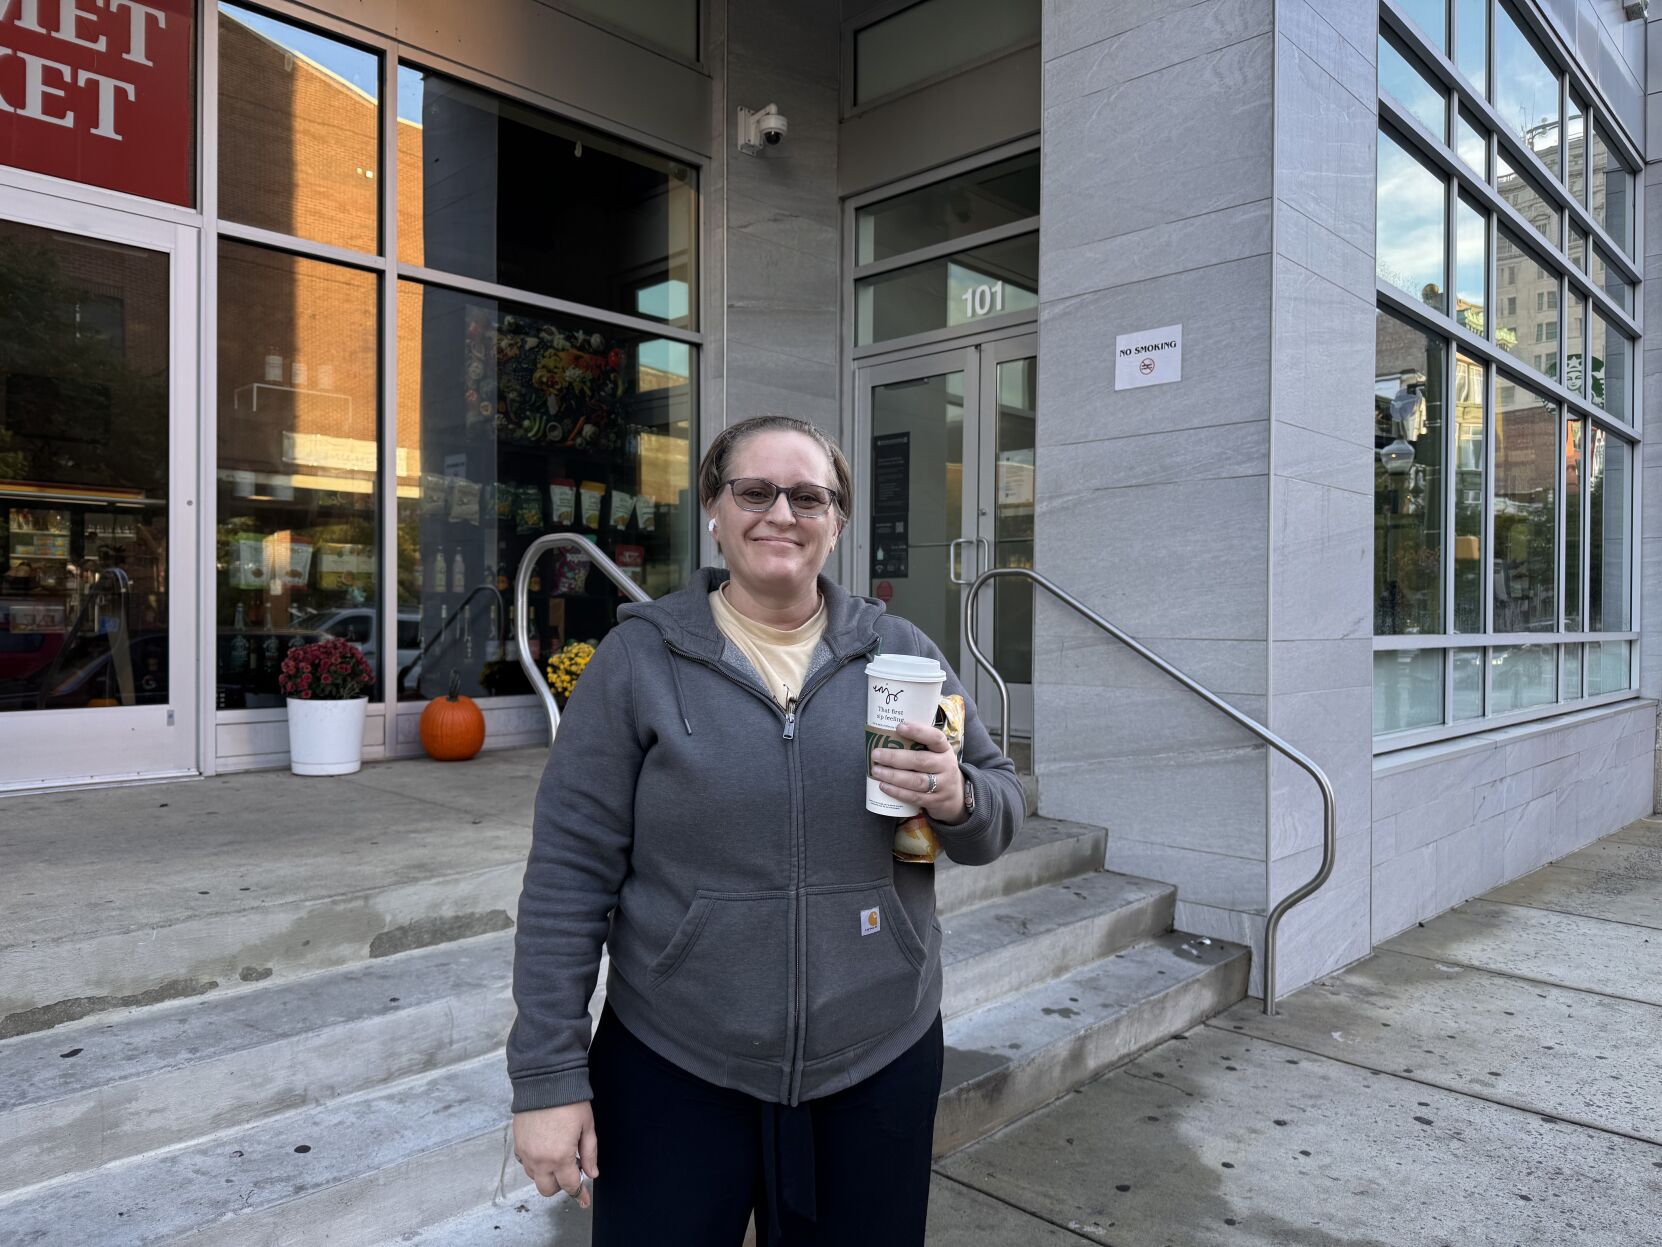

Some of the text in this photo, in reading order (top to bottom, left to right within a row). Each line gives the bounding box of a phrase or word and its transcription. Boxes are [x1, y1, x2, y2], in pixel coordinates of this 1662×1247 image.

[0, 46, 136, 141] ET
[961, 280, 1003, 318] 101
[1119, 340, 1177, 358] NO SMOKING
